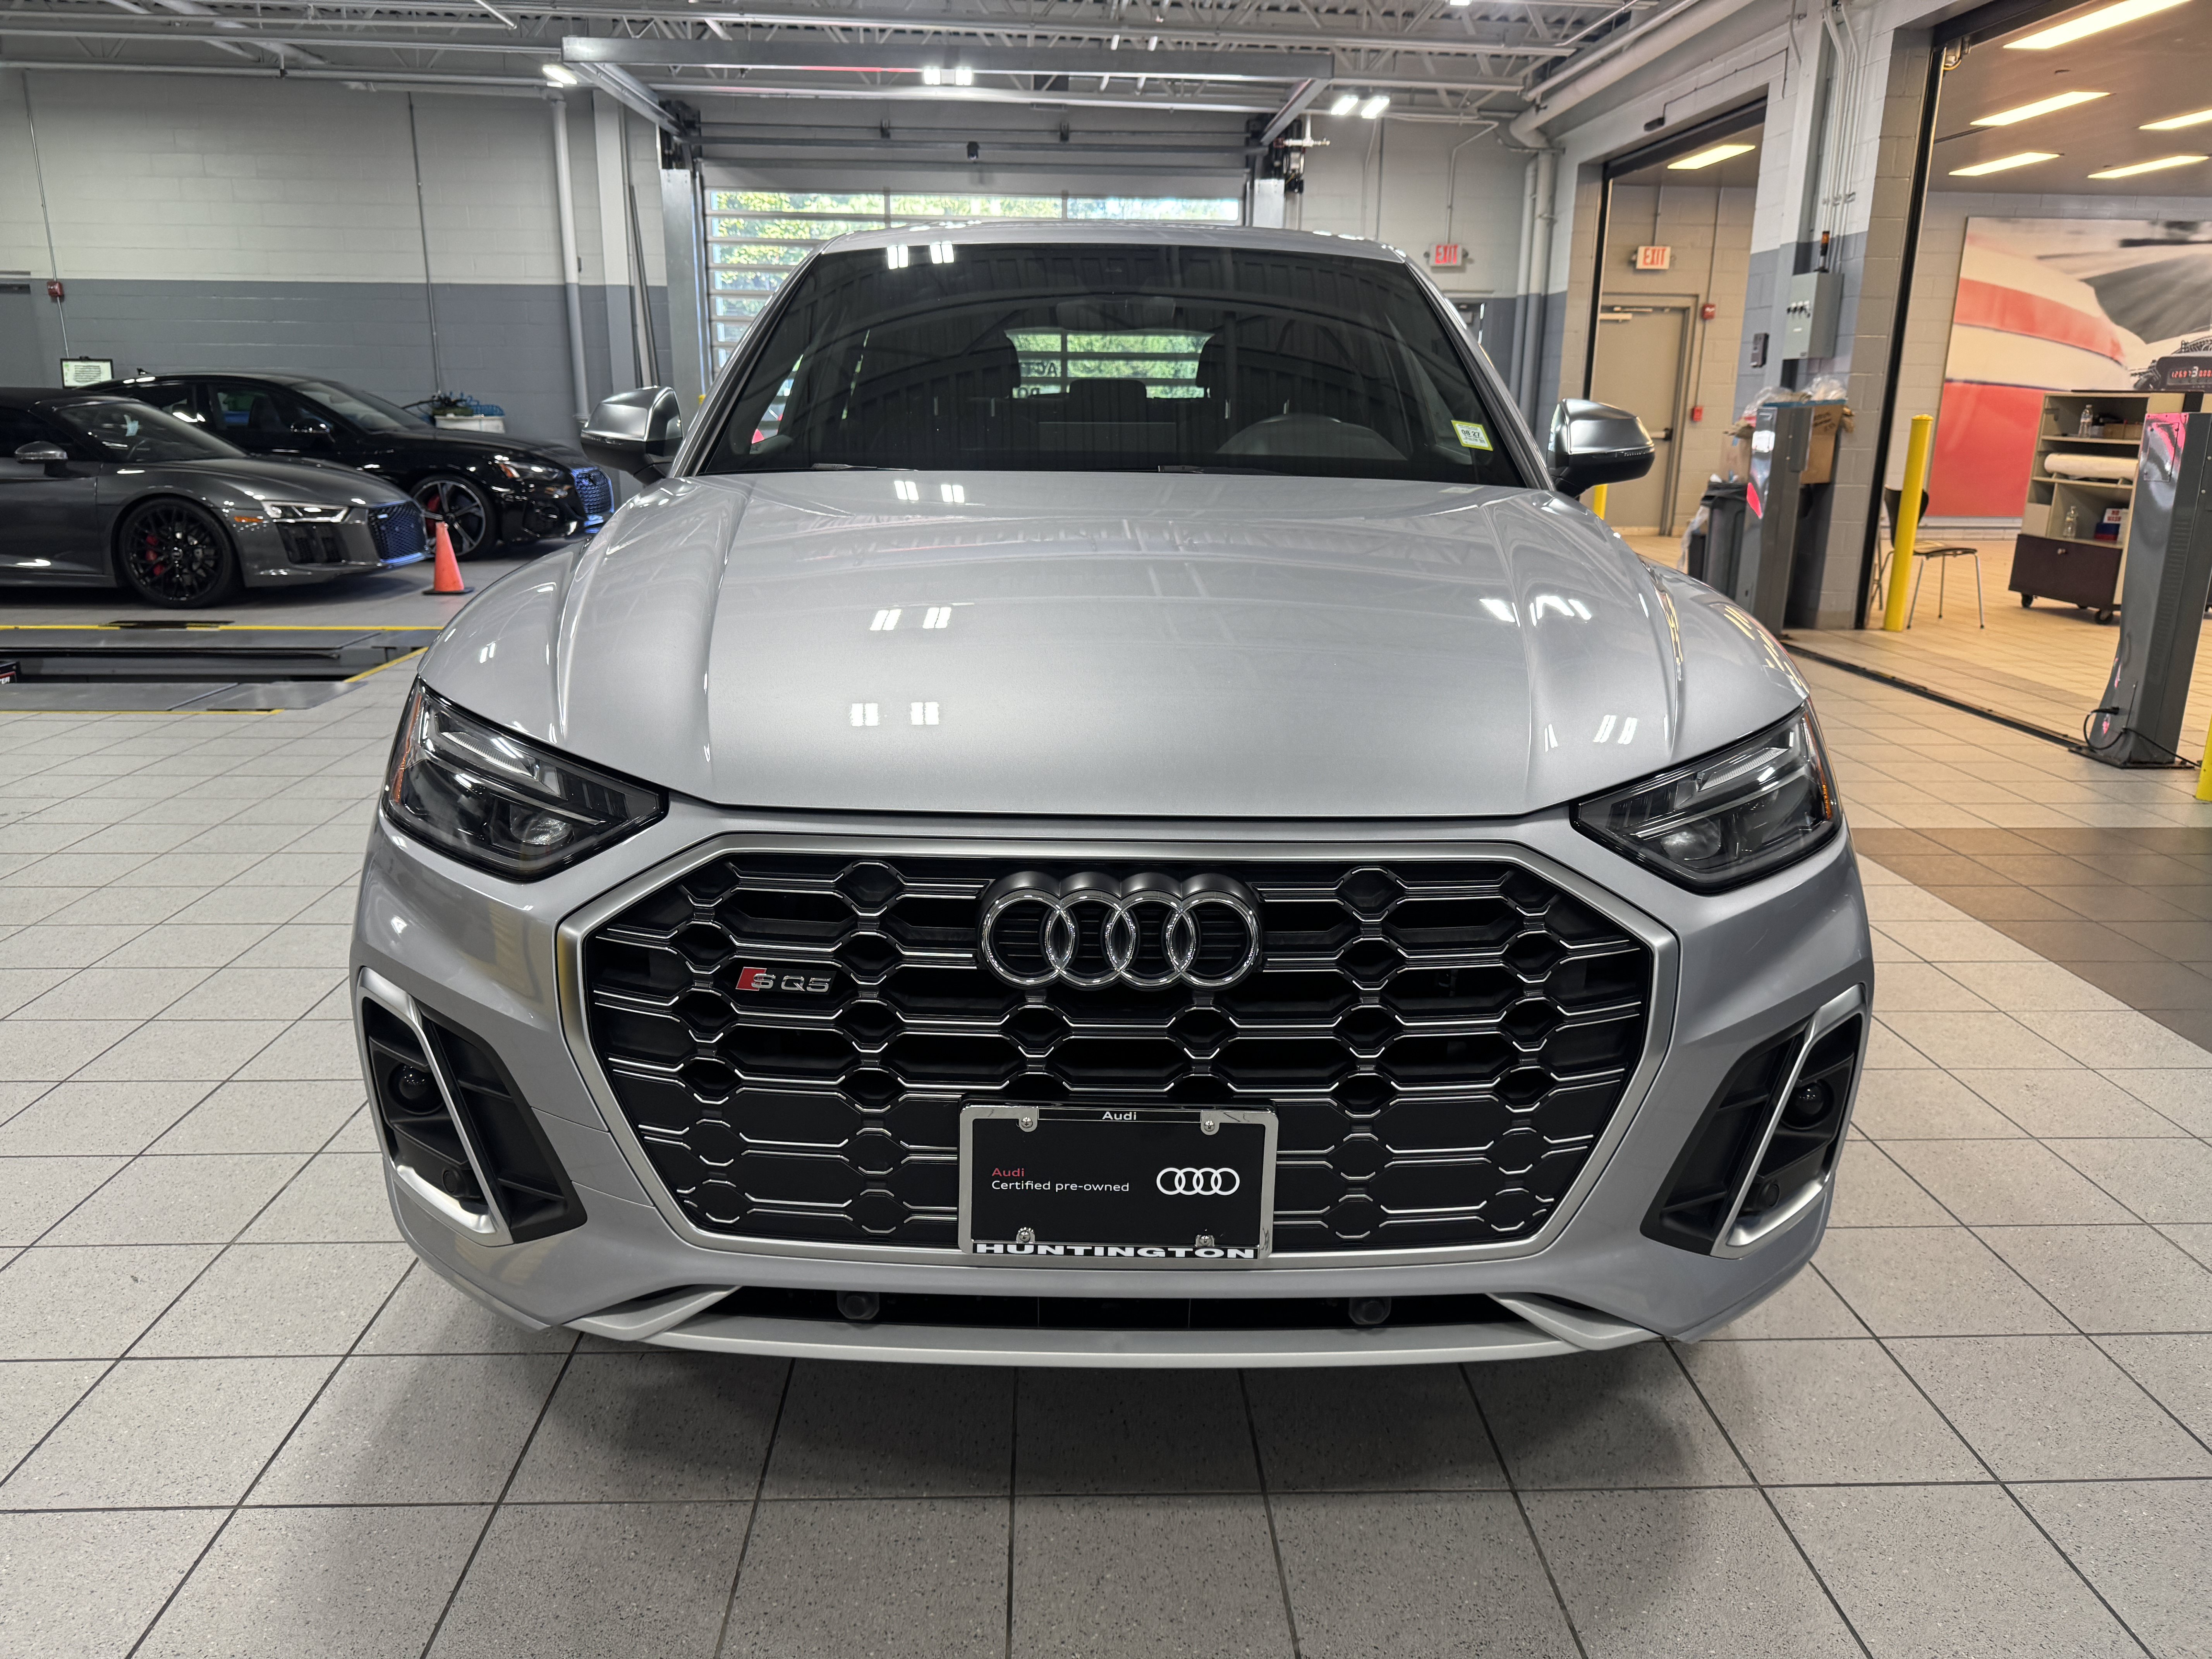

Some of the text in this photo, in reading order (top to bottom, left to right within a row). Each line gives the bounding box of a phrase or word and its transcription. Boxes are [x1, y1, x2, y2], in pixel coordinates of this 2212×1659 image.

[1435, 244, 1459, 264] EXIT
[1643, 247, 1667, 266] EXIT
[751, 973, 831, 992] SQ5
[1102, 1111, 1137, 1120] Audi
[991, 1168, 1025, 1177] Audi
[991, 1180, 1129, 1192] Certified pre-owned
[976, 1243, 1254, 1259] HUNTINGTON
